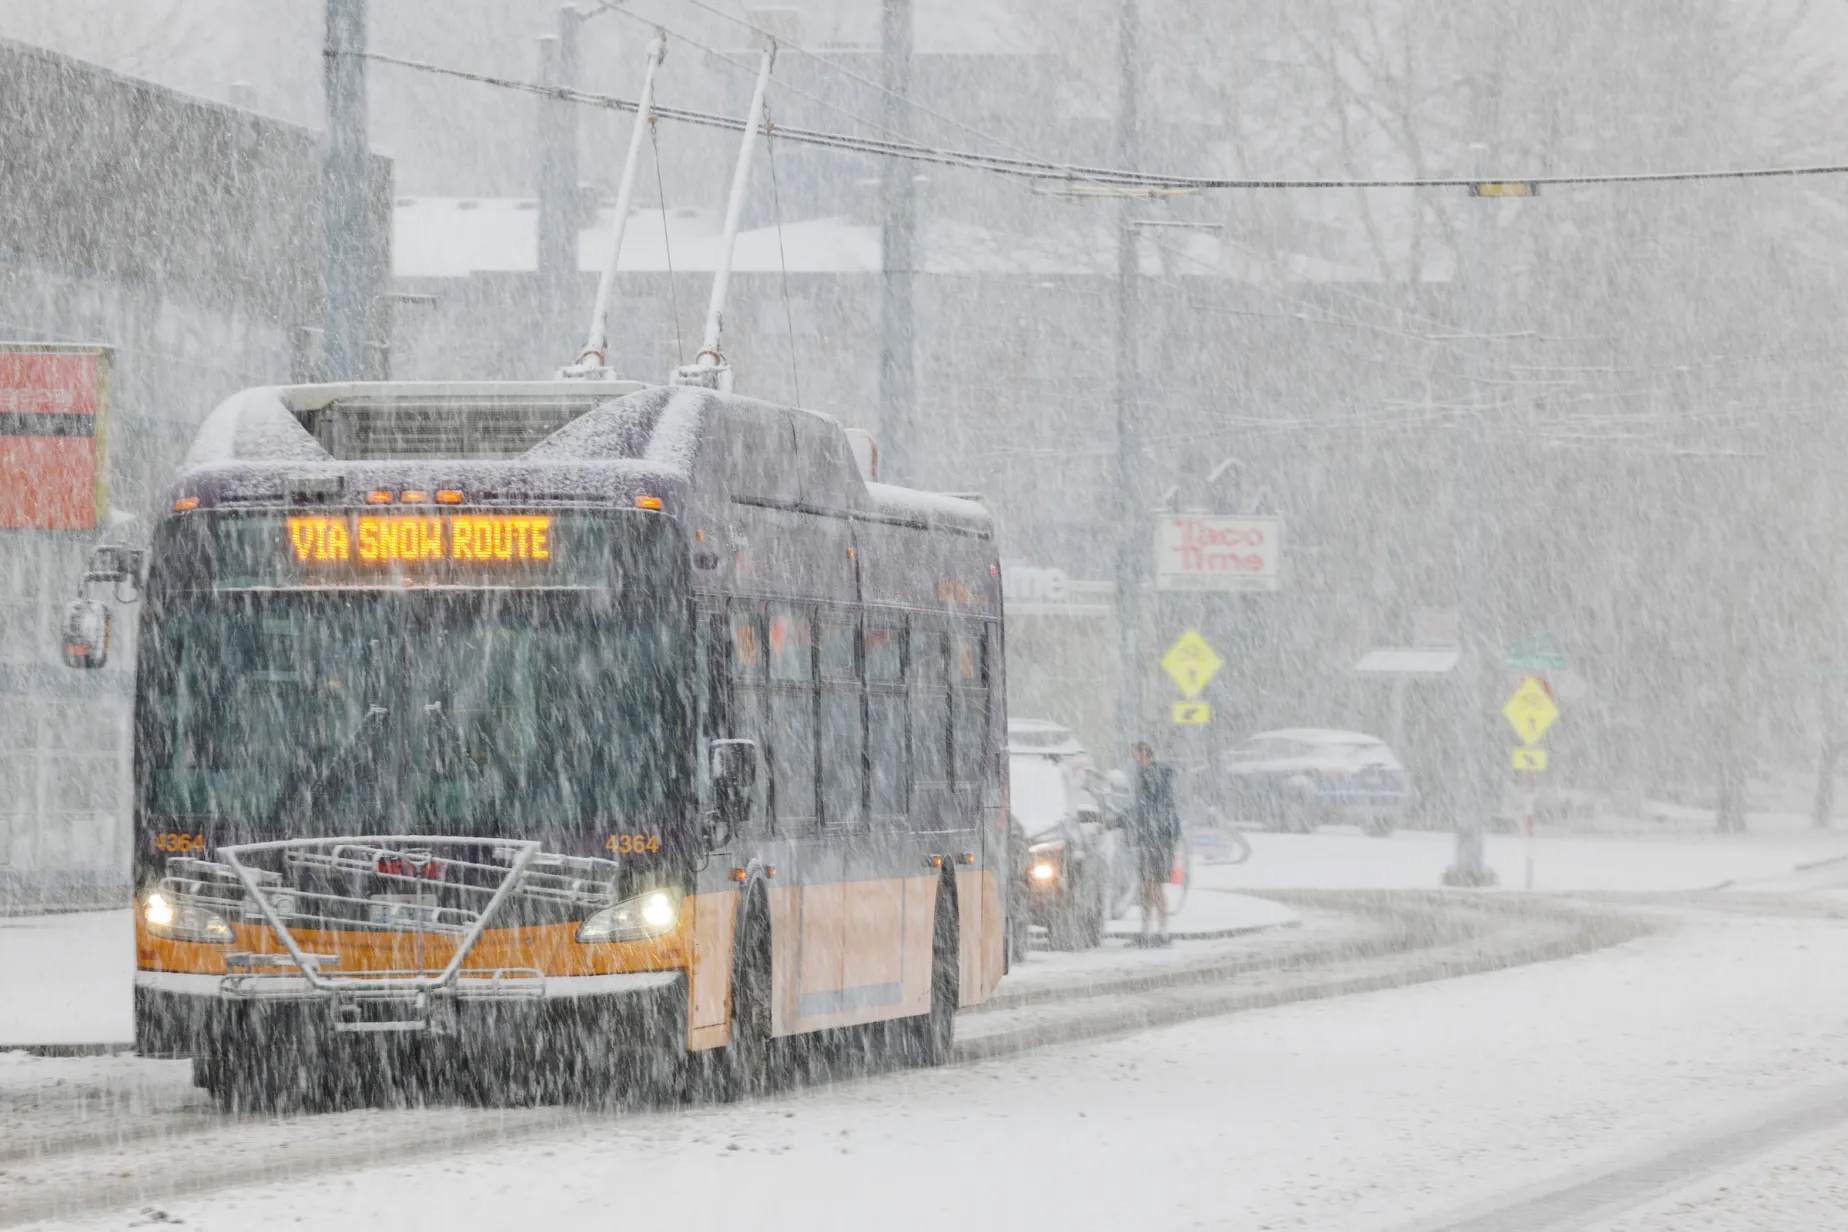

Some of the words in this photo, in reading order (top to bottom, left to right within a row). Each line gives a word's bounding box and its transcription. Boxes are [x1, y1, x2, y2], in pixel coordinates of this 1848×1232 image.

[290, 518, 348, 560] VIA
[359, 518, 441, 560] SNOW
[453, 518, 549, 560] ROUTE
[1171, 519, 1264, 546] Taco
[1169, 546, 1265, 571] Time
[155, 833, 205, 852] 4364
[605, 834, 659, 853] 4364
